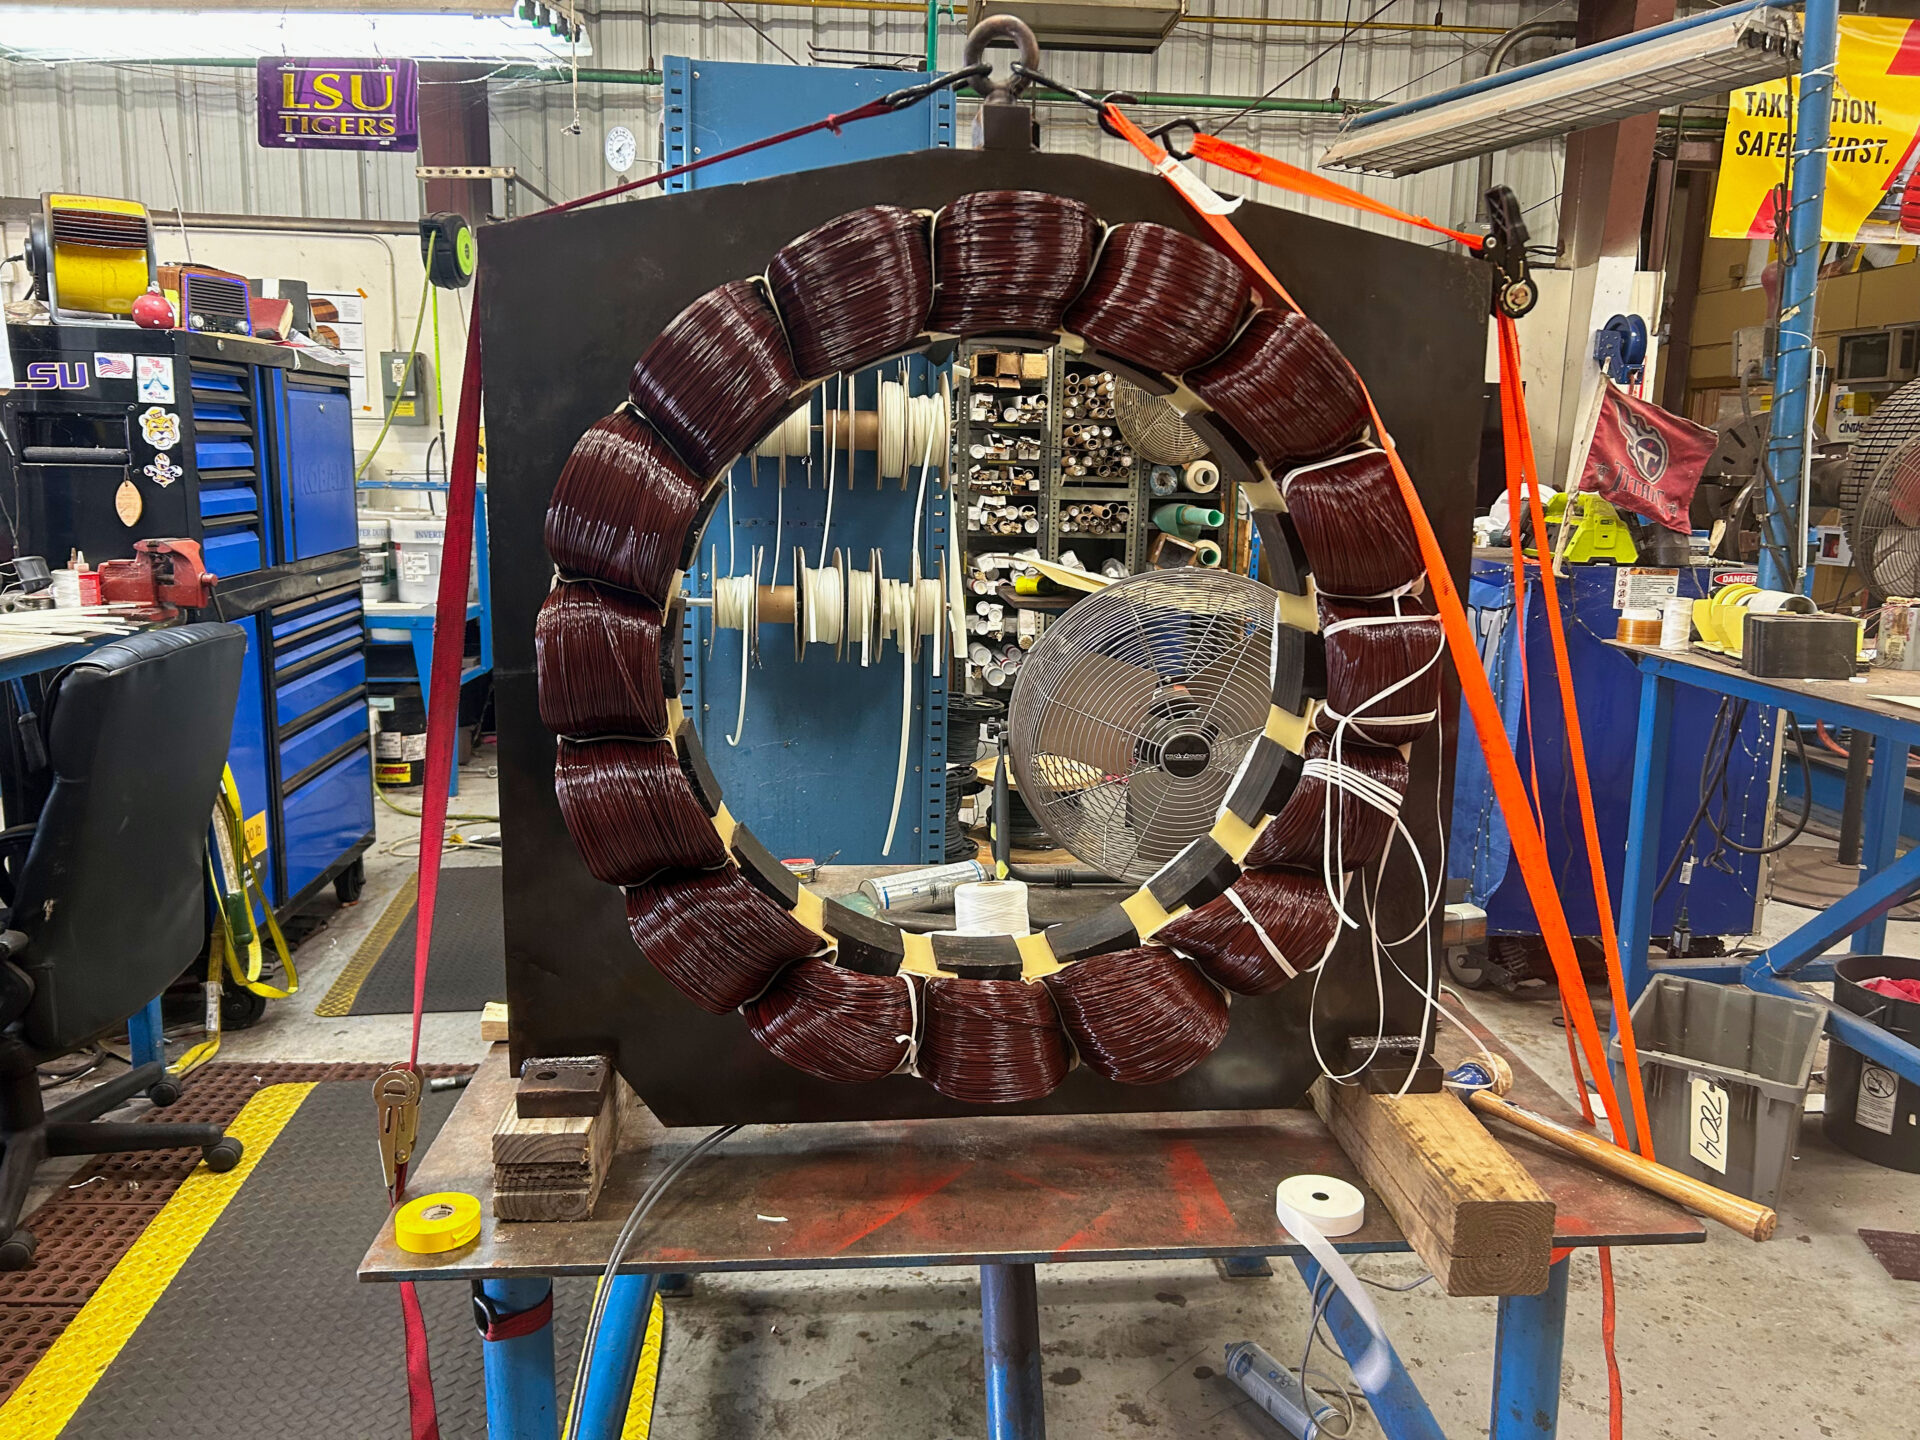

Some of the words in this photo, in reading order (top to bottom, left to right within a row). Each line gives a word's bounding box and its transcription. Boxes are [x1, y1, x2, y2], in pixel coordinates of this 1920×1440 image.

[282, 73, 393, 111] LSU
[279, 115, 396, 136] TIGERS
[1831, 98, 1882, 125] TION.
[1736, 130, 1797, 158] SAFET
[14, 362, 90, 390] SU
[1722, 574, 1757, 583] DANGER
[1699, 1091, 1722, 1159] 7804
